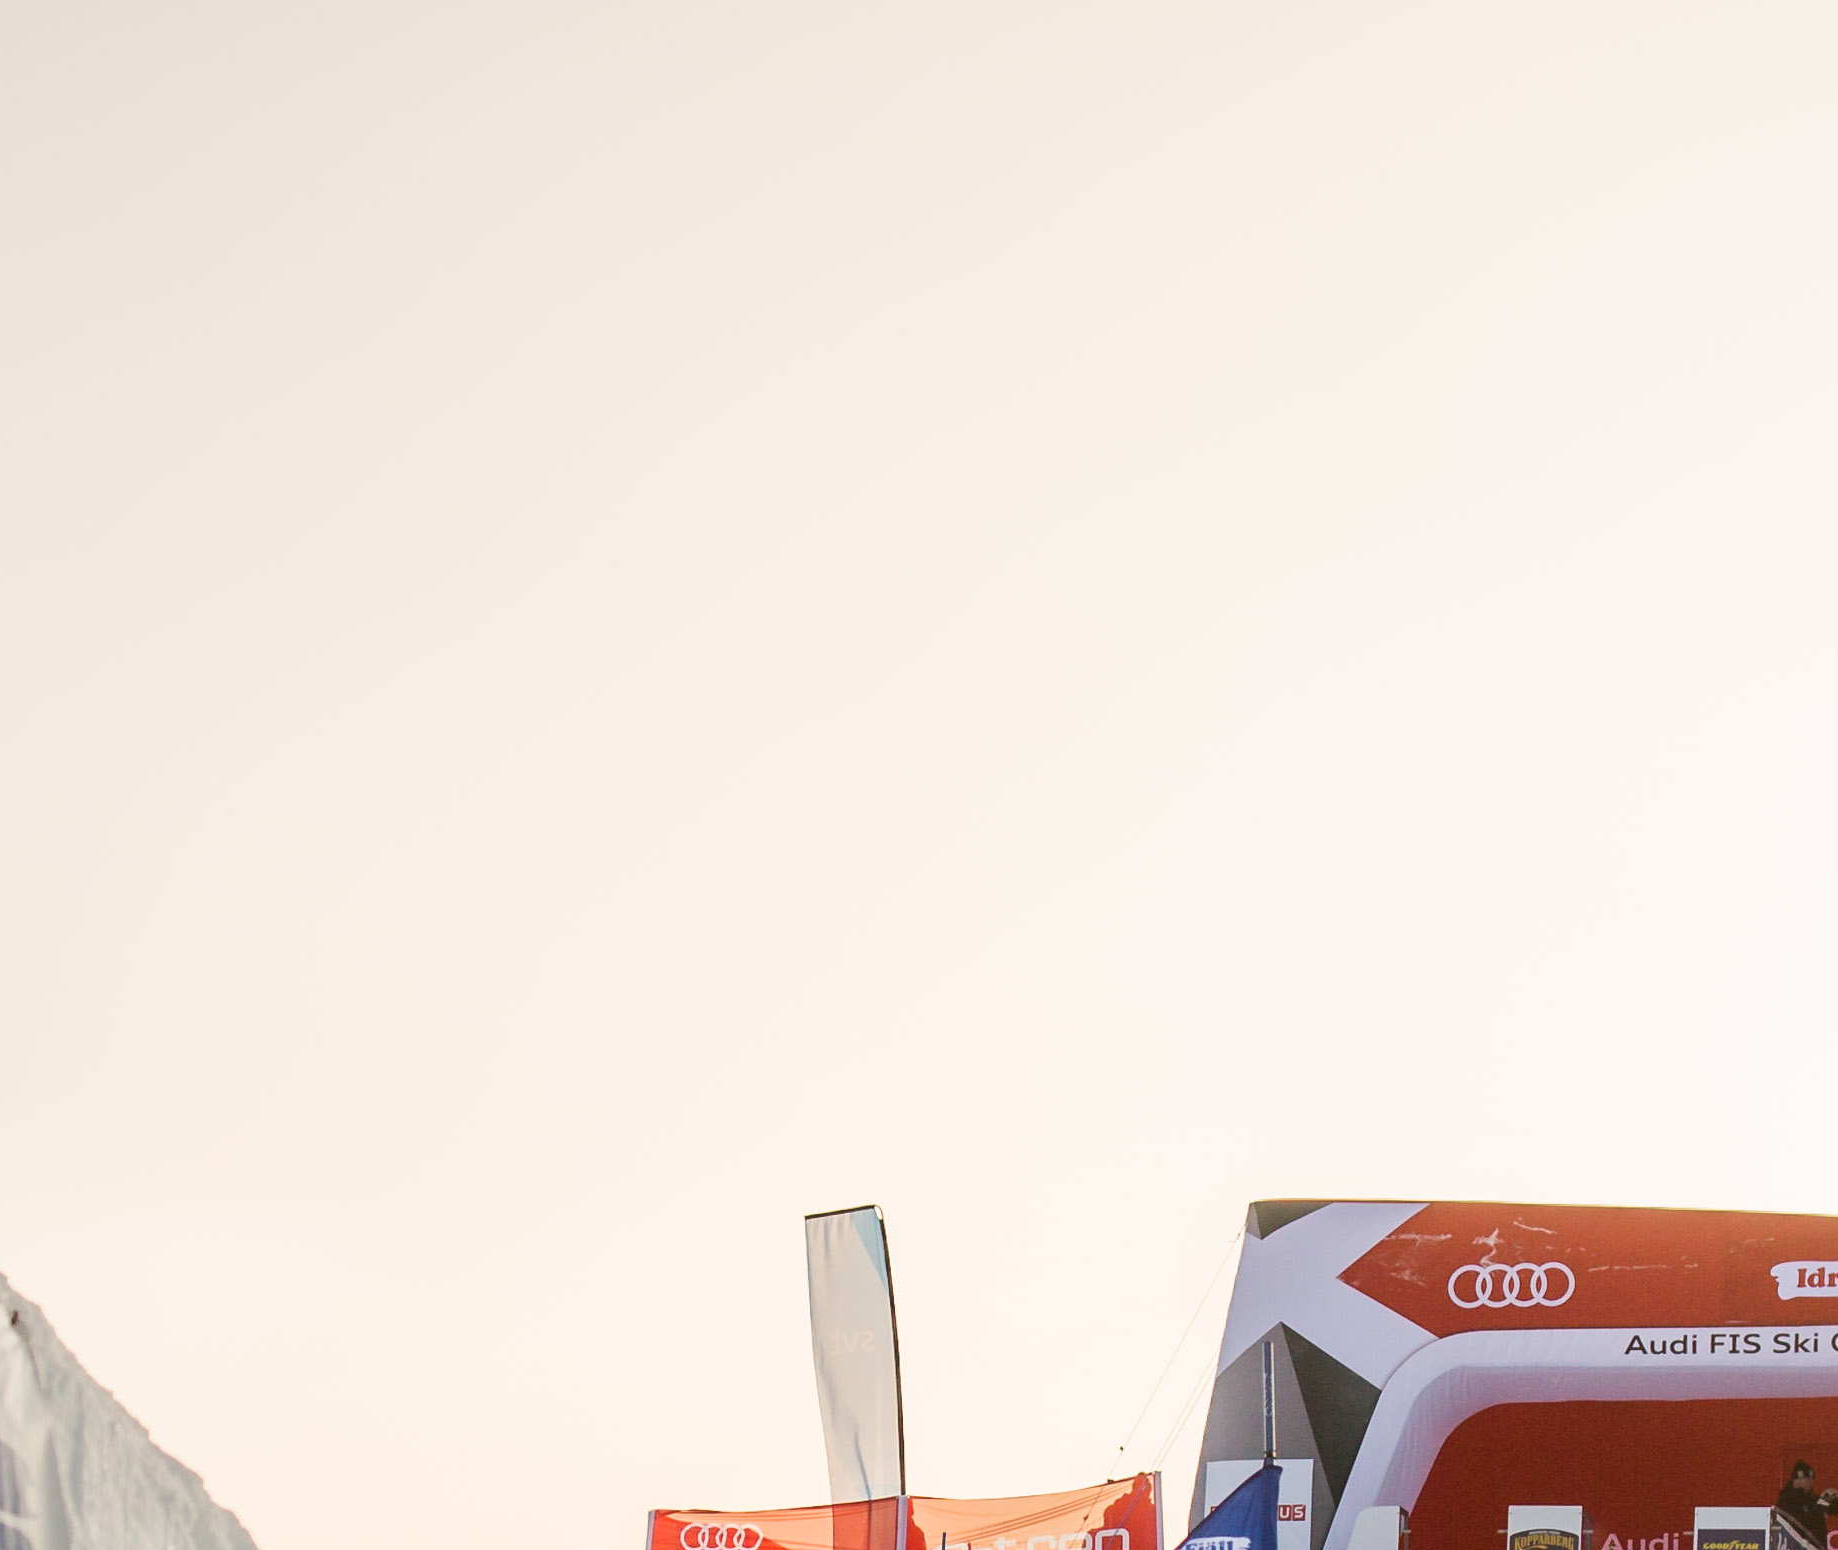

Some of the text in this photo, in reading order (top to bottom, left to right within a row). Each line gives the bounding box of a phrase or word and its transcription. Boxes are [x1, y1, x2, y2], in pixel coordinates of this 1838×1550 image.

[1624, 1333, 1698, 1355] Audi
[1710, 1333, 1762, 1354] FIS
[1772, 1332, 1819, 1354] Ski
